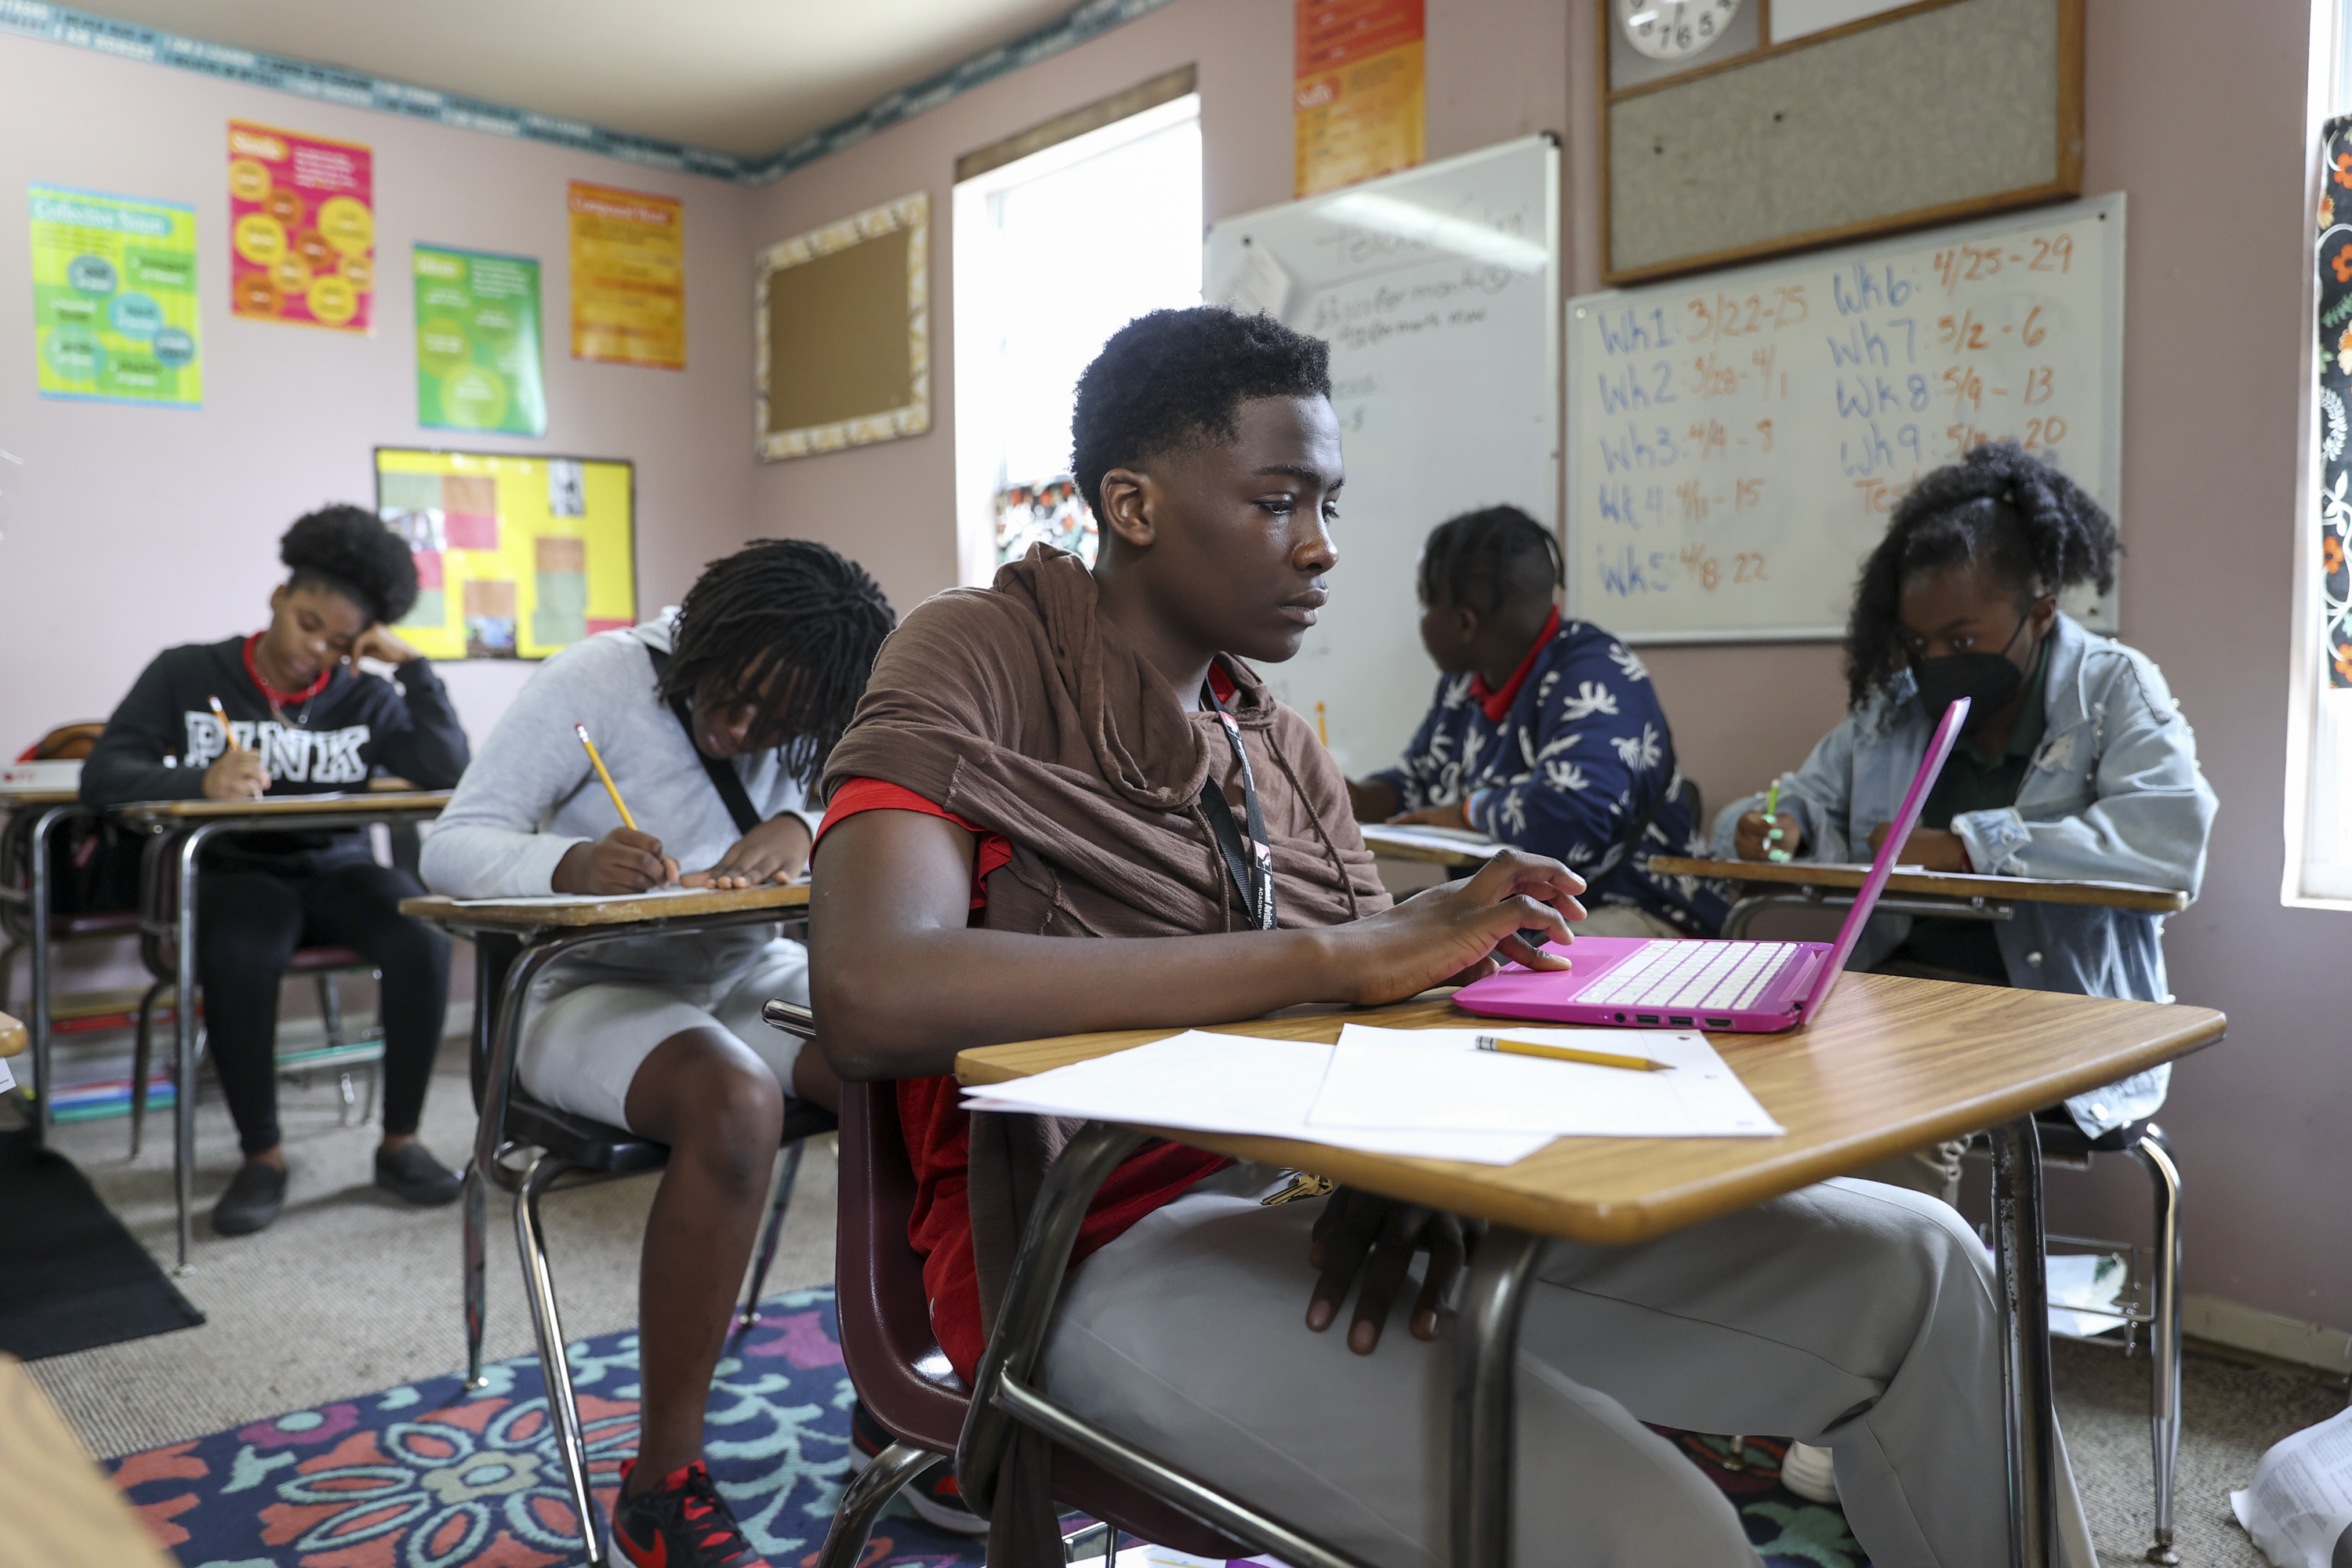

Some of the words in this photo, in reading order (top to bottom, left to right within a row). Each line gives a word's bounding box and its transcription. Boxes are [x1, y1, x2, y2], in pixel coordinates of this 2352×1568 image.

[2021, 305, 2047, 349] 6
[2023, 365, 2053, 406] 13
[2023, 416, 2068, 451] 20
[1734, 477, 1766, 513] 15
[1264, 873, 1273, 905] National
